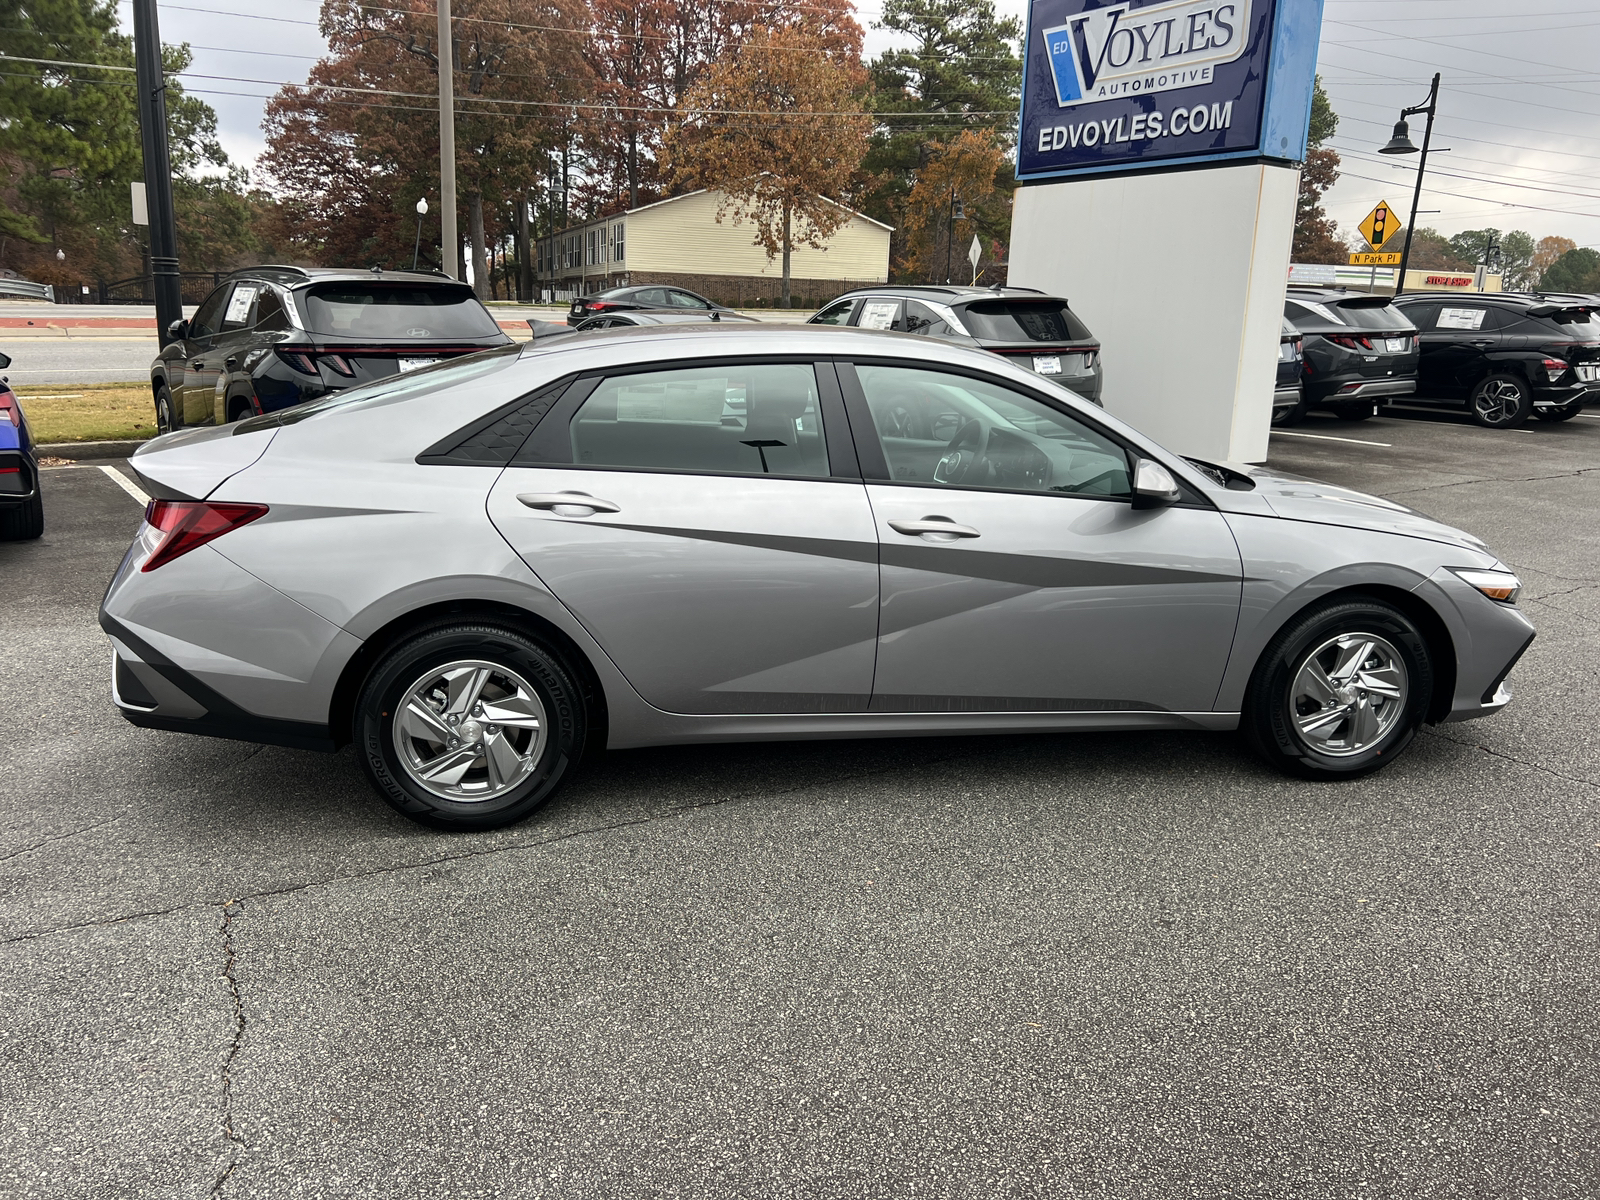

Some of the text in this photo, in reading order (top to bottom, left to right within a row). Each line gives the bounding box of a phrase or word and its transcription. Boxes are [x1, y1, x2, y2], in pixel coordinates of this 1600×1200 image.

[1053, 41, 1068, 55] ED
[1070, 5, 1235, 90] VOYLES
[1098, 67, 1211, 97] AUTOMOTIVE
[1038, 101, 1233, 152] EDVOYLES.COM
[1354, 254, 1361, 263] N
[1364, 254, 1383, 263] Park
